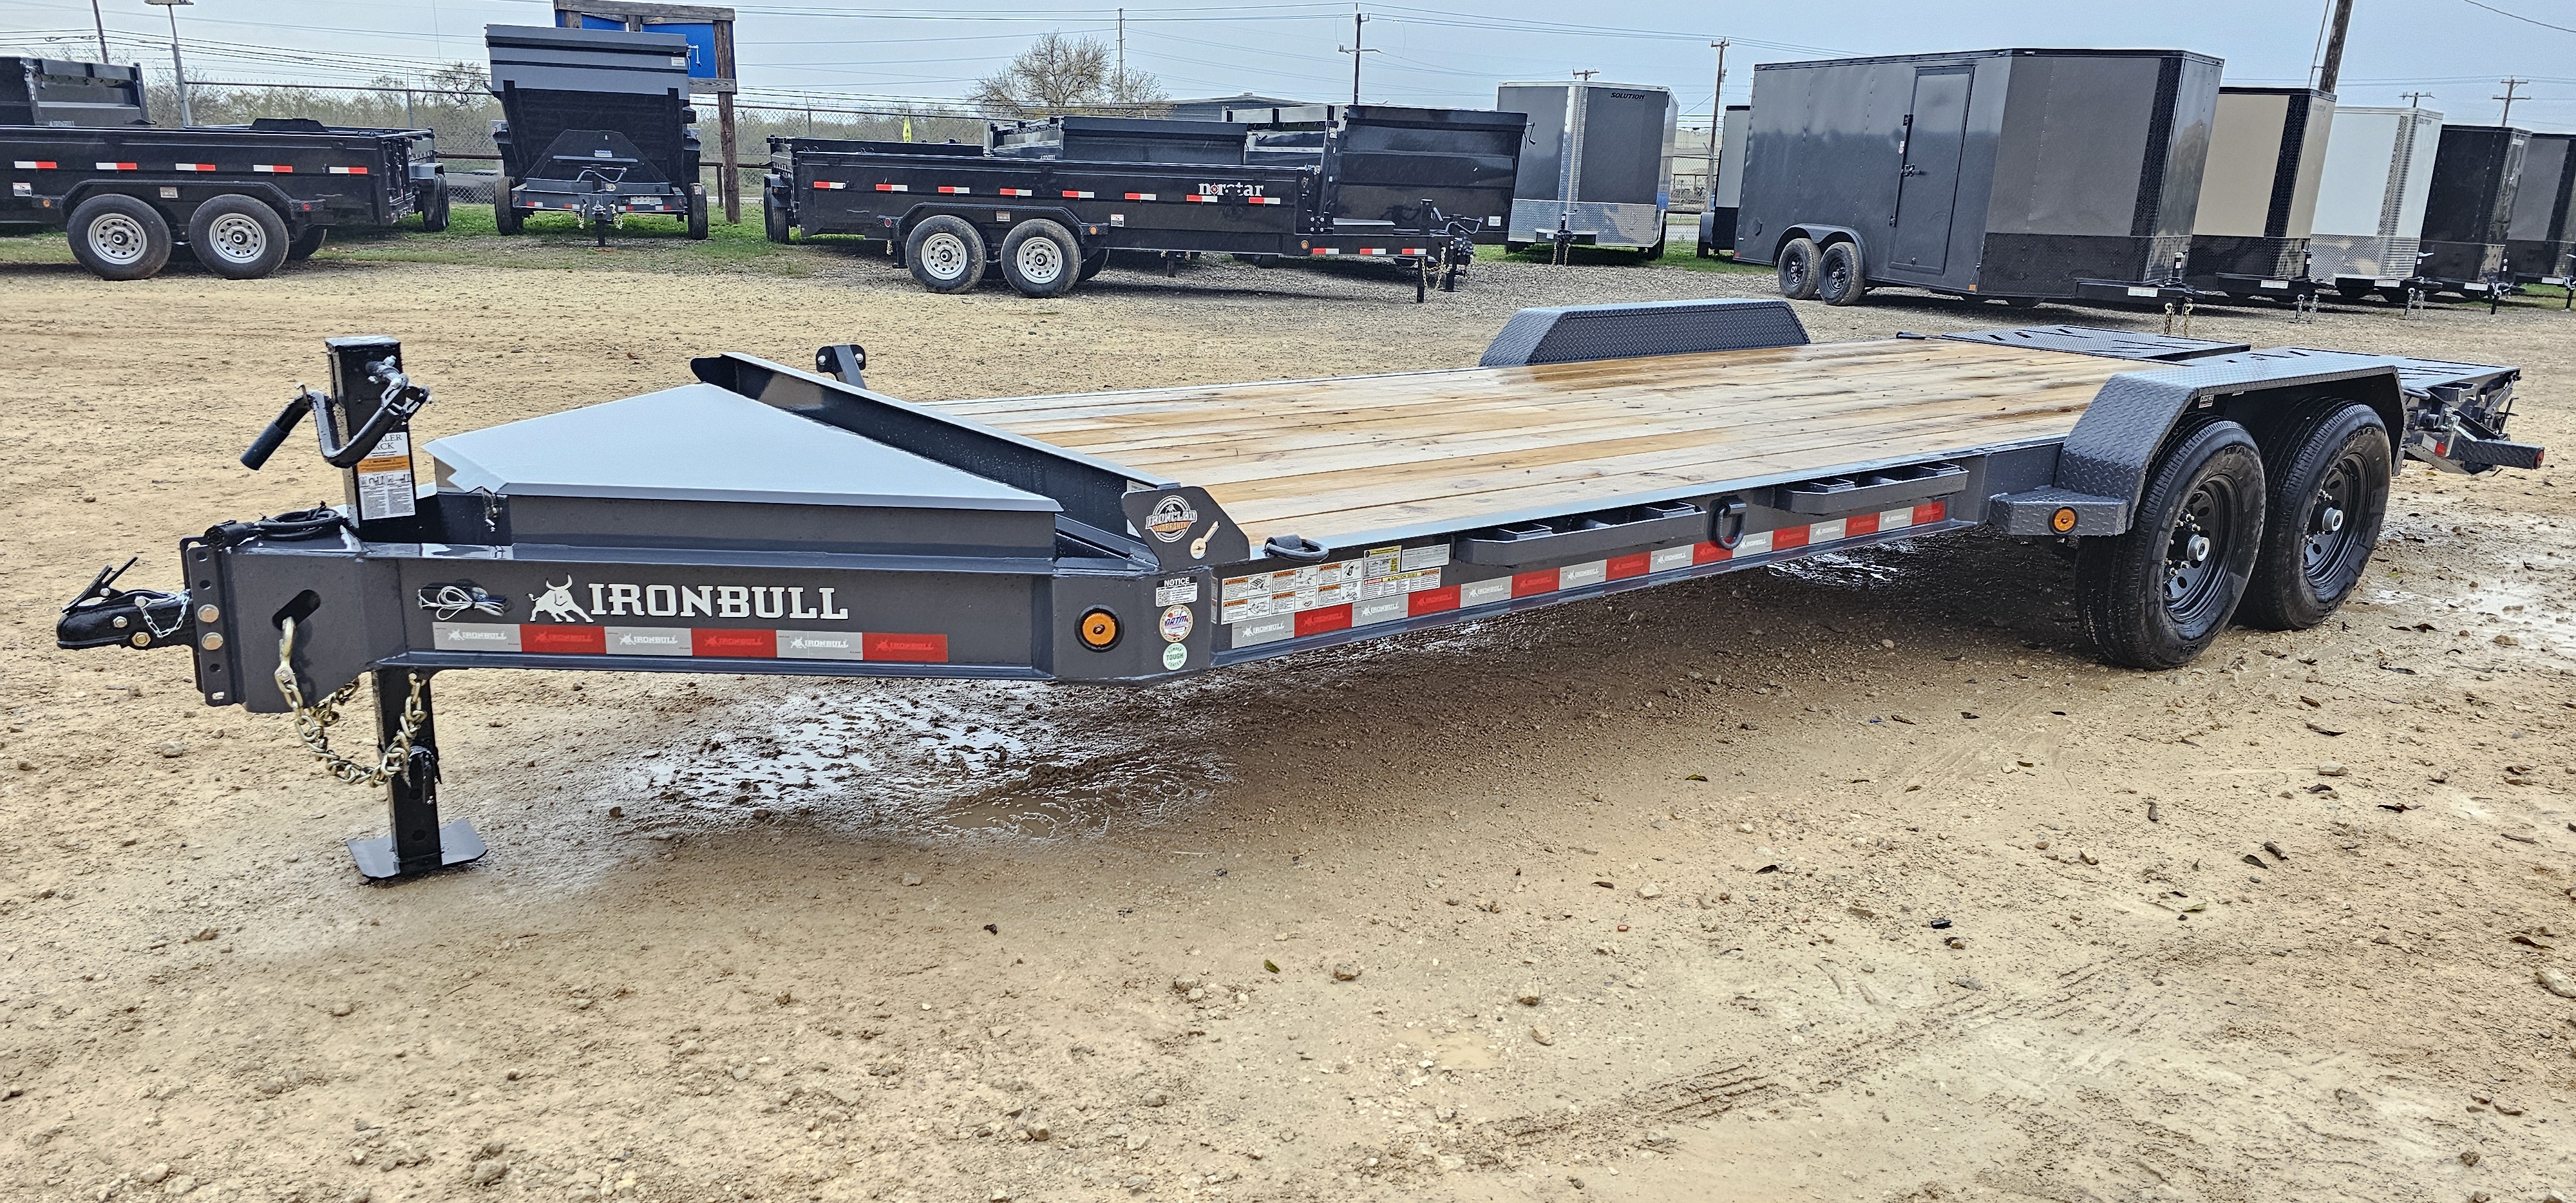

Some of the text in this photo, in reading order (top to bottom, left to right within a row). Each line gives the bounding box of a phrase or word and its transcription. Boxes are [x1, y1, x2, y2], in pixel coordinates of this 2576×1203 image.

[1148, 511, 1196, 527] IRONCLAD
[1155, 522, 1189, 532] WARRANTY
[1575, 567, 1600, 578] IRONBULL
[1164, 577, 1190, 587] NOTICE
[1477, 583, 1504, 594] IRONBULL
[589, 583, 849, 620] IRONBULL
[1370, 602, 1399, 614] IRONBULL
[1253, 621, 1285, 634] IRONBULL
[462, 630, 507, 641] IRONBULL
[633, 634, 678, 644] IRONBULL
[804, 638, 849, 649] IRONBULL
[1166, 653, 1184, 661] TOUGH
